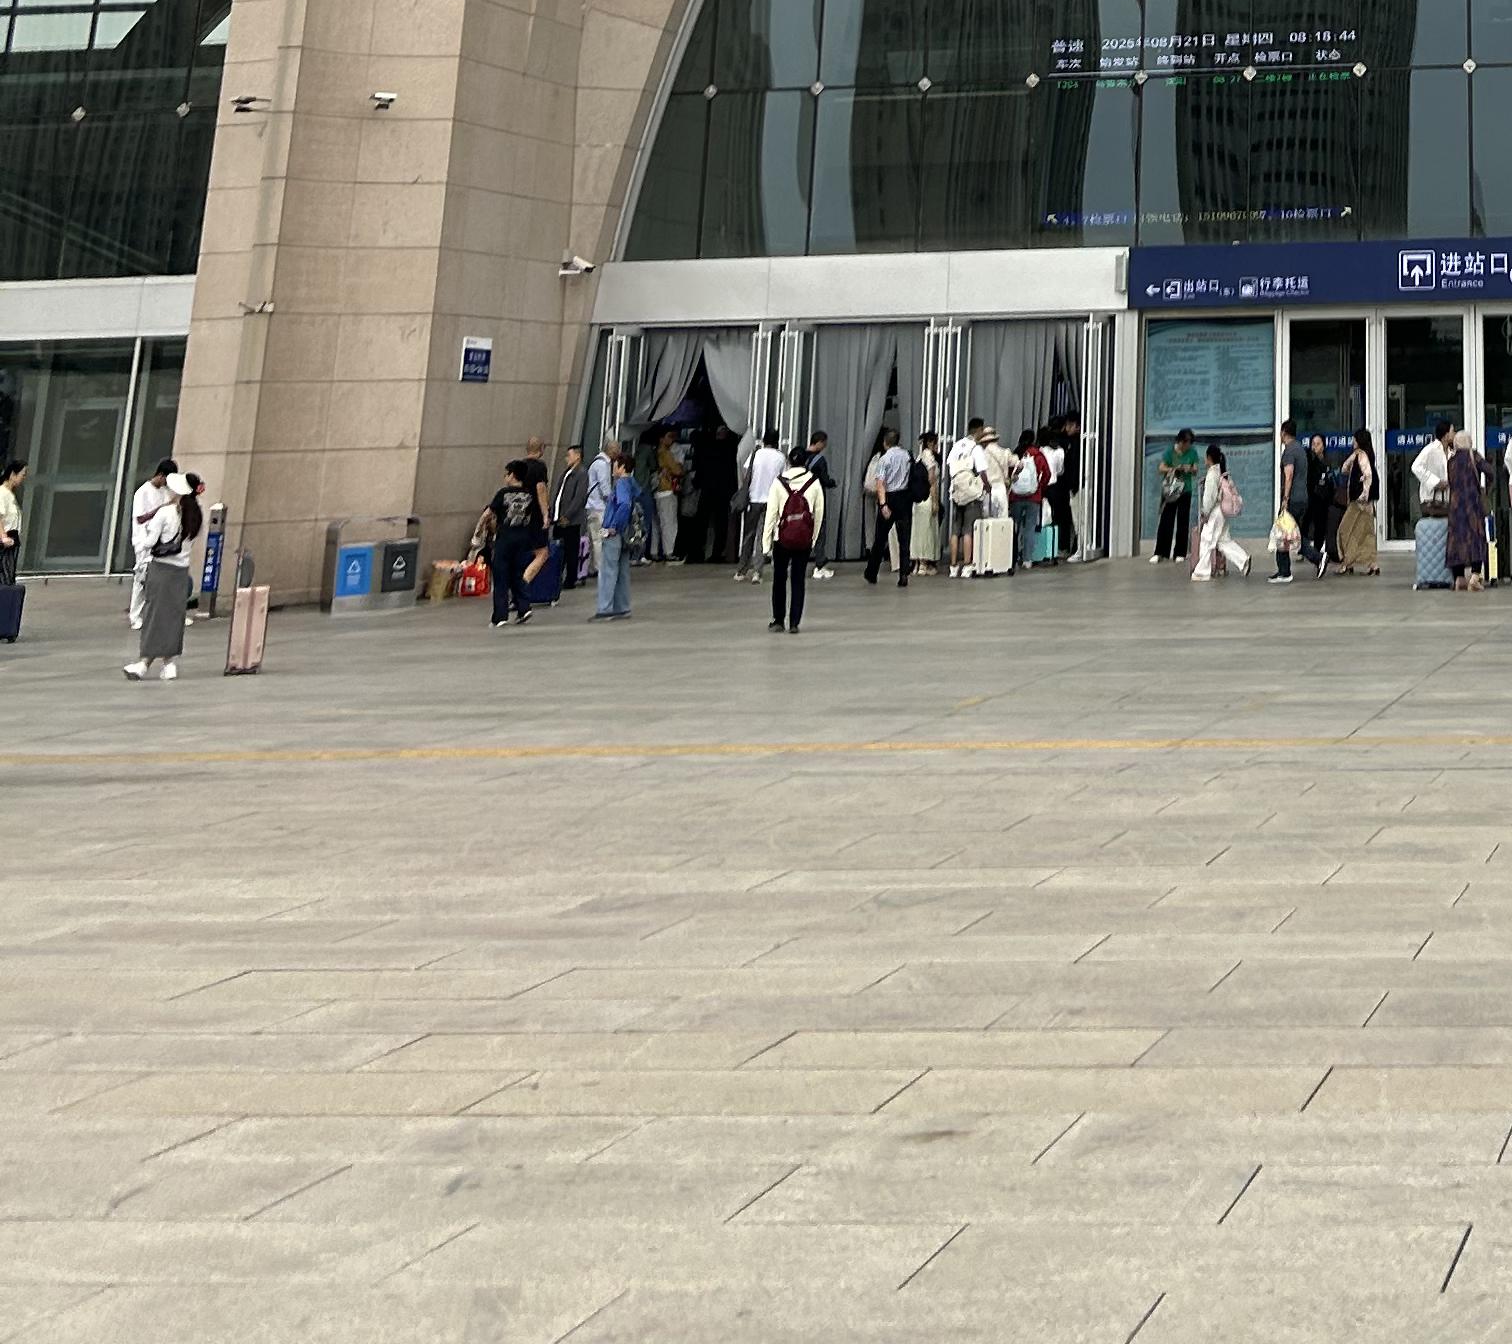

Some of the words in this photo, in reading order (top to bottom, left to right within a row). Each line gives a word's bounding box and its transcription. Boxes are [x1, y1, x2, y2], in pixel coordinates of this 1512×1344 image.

[1225, 32, 1273, 46] 星期四
[1255, 51, 1292, 63] 检票口
[1441, 278, 1483, 288] Entrance
